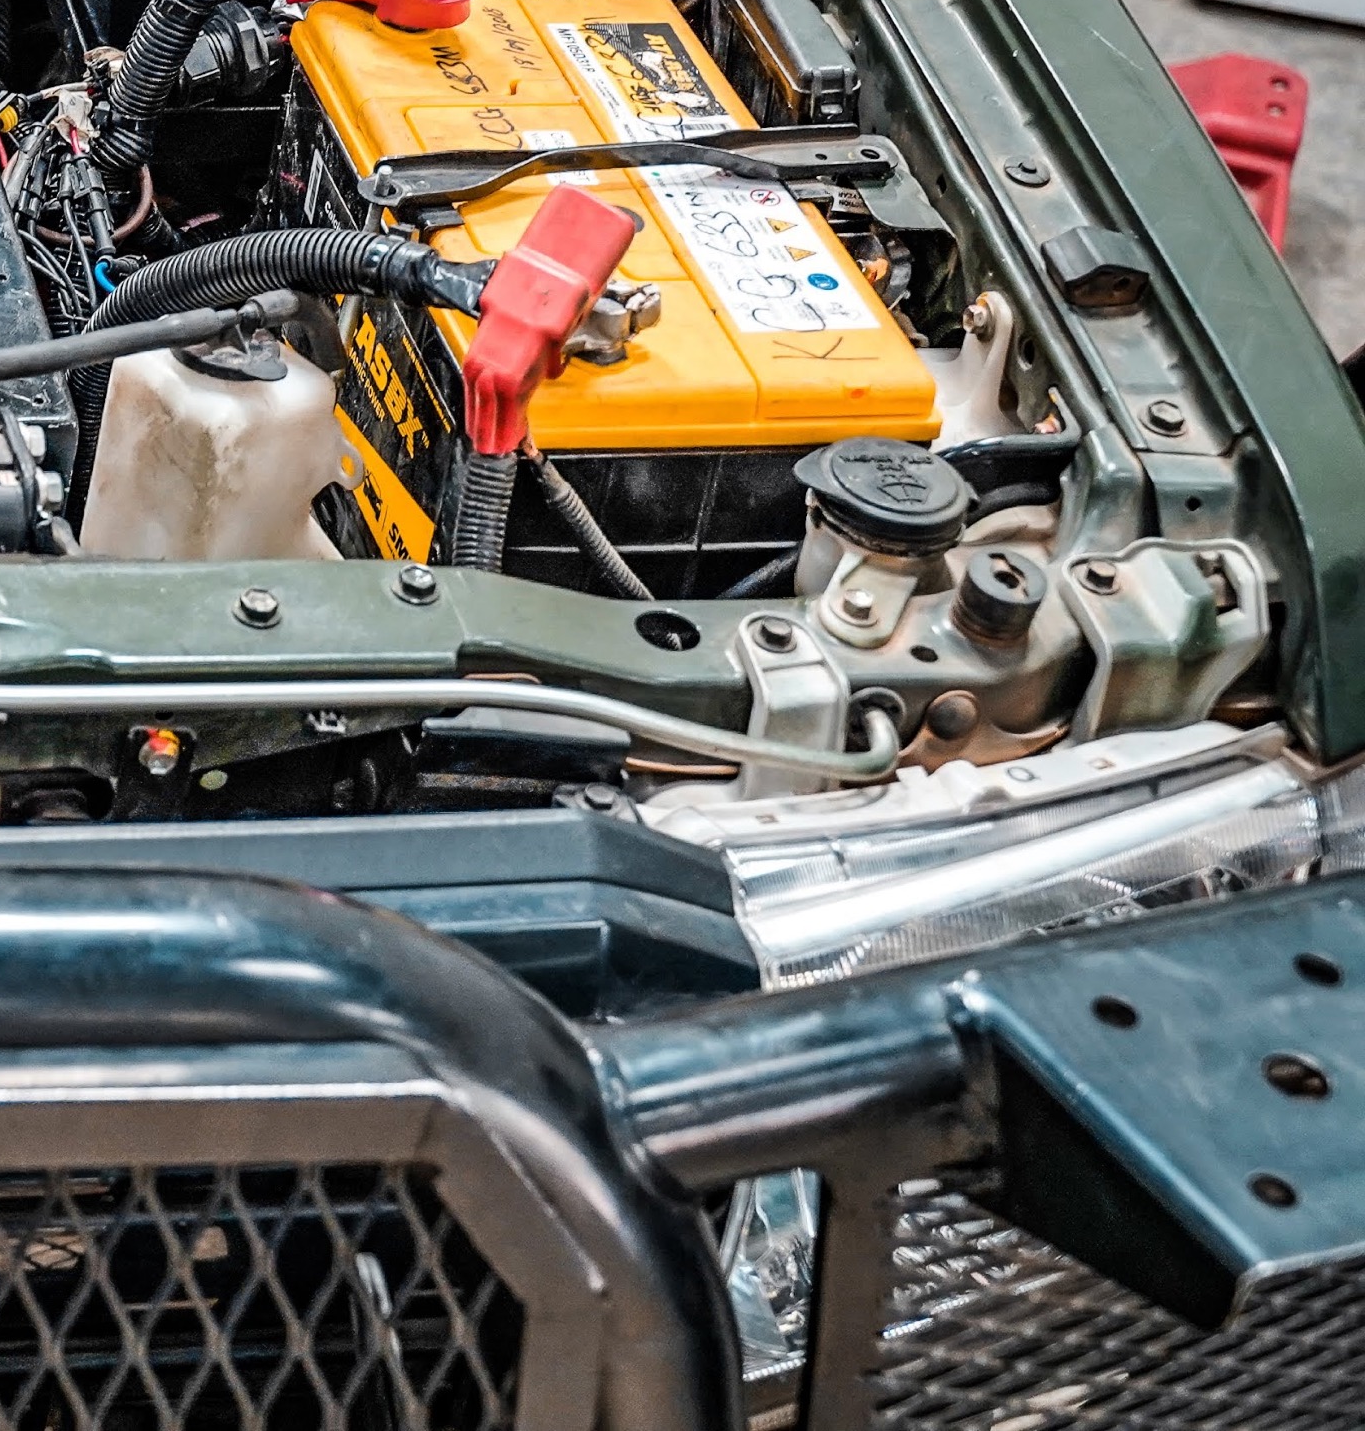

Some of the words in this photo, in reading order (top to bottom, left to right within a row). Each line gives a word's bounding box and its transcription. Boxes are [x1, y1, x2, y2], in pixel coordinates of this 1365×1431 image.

[353, 312, 424, 460] ASBX
[365, 380, 386, 423] POWER
[388, 521, 413, 562] SM
